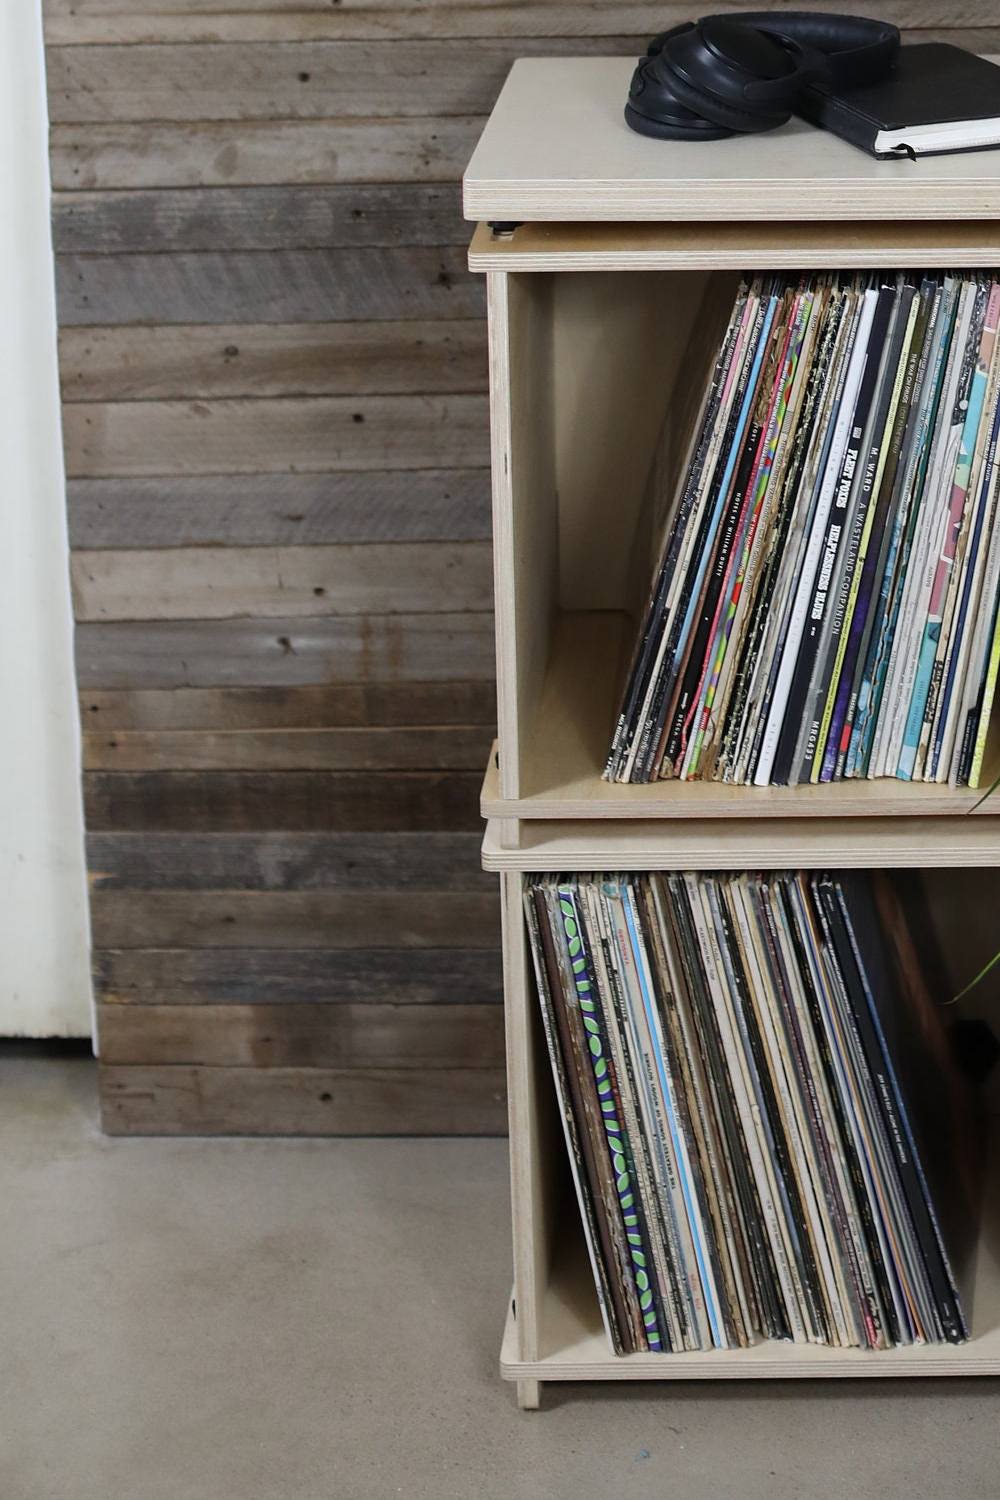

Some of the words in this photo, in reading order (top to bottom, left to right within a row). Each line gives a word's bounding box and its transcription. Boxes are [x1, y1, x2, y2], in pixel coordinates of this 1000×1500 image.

[778, 439, 786, 453] THE
[869, 446, 878, 458] M.
[841, 448, 858, 479] FLEET
[862, 462, 874, 492] WARD
[731, 492, 741, 513] NOTES
[835, 478, 851, 509] FOXES
[720, 526, 732, 554] WILLIAM
[844, 512, 863, 572] WASTELAND
[817, 523, 841, 590] HELPLESSNESS
[810, 590, 827, 620] BLUES
[831, 574, 850, 635] COMPANION
[804, 719, 819, 760] MRG433
[649, 1082, 659, 1106] WOODY
[662, 1142, 673, 1175] GREATEST
